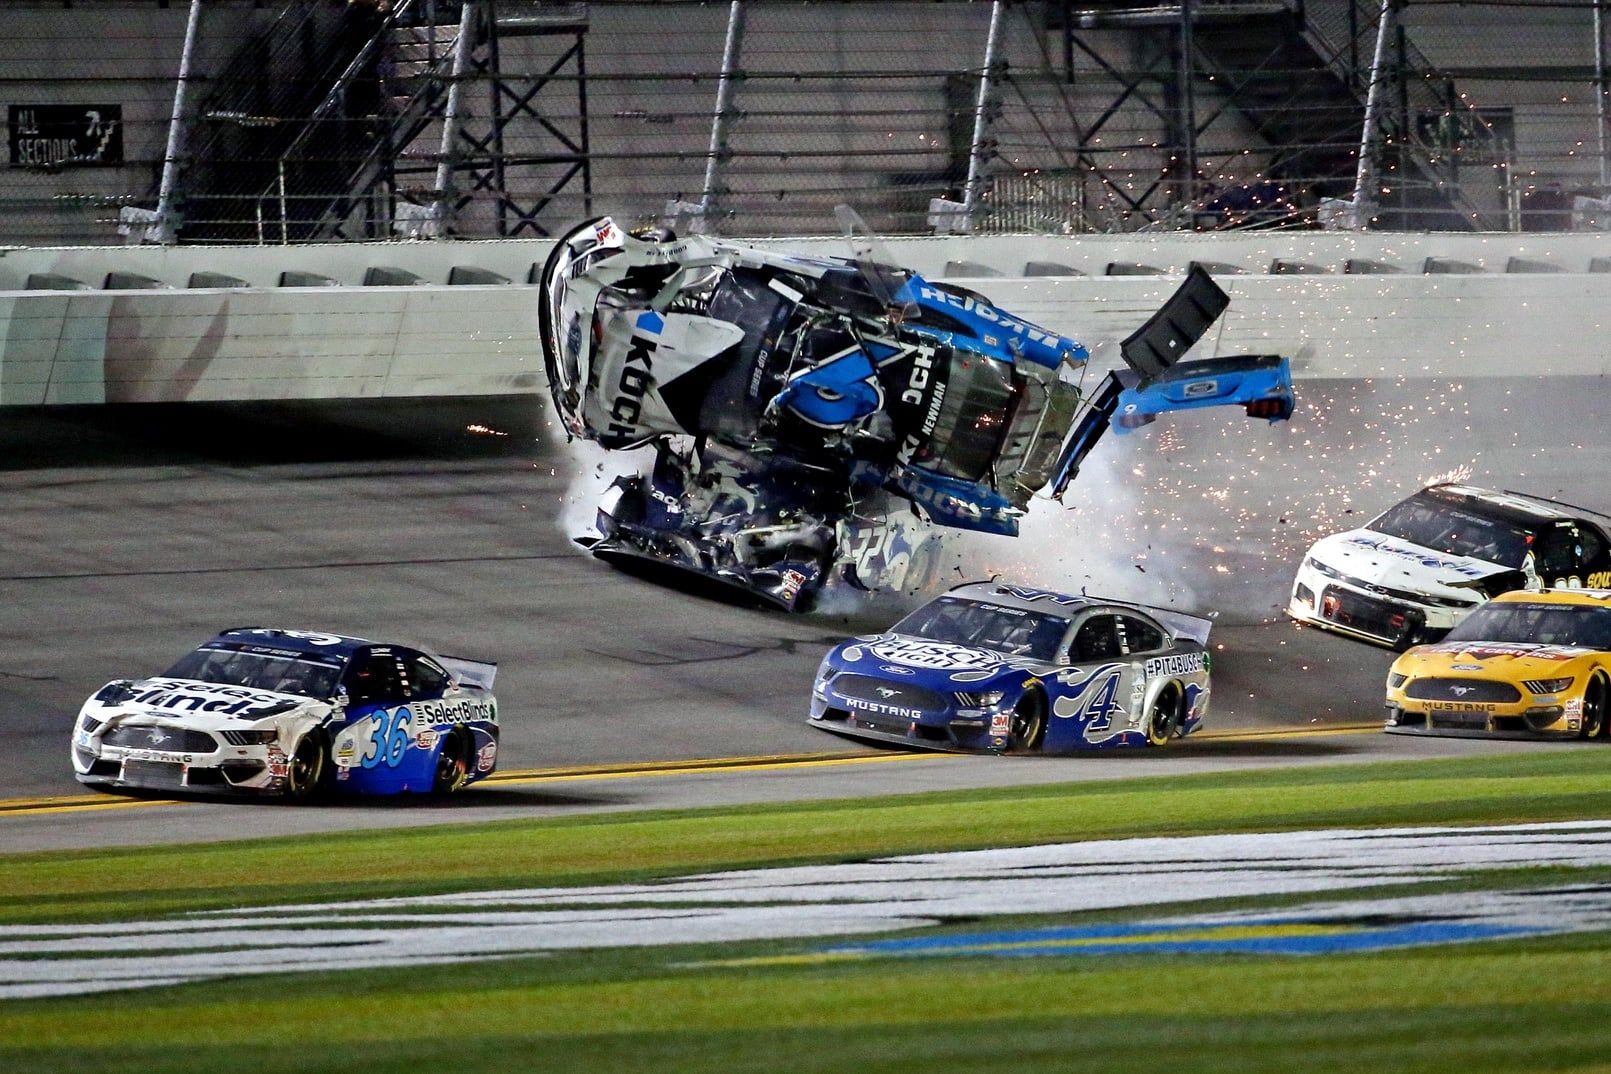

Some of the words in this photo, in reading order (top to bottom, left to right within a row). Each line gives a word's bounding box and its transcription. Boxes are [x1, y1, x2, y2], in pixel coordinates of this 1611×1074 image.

[18, 110, 38, 134] ALL
[18, 138, 77, 164] SECTIONS
[757, 349, 769, 369] CUP
[750, 367, 763, 398] SERIES
[920, 380, 947, 436] NEWMAN
[1587, 571, 1611, 588] SOU
[870, 639, 1000, 672] BUSCH
[882, 651, 957, 668] LIGHT
[846, 698, 922, 719] MUSTANG
[1087, 671, 1122, 733] 4
[1422, 702, 1496, 712] MUSTANG
[361, 705, 412, 770] 36
